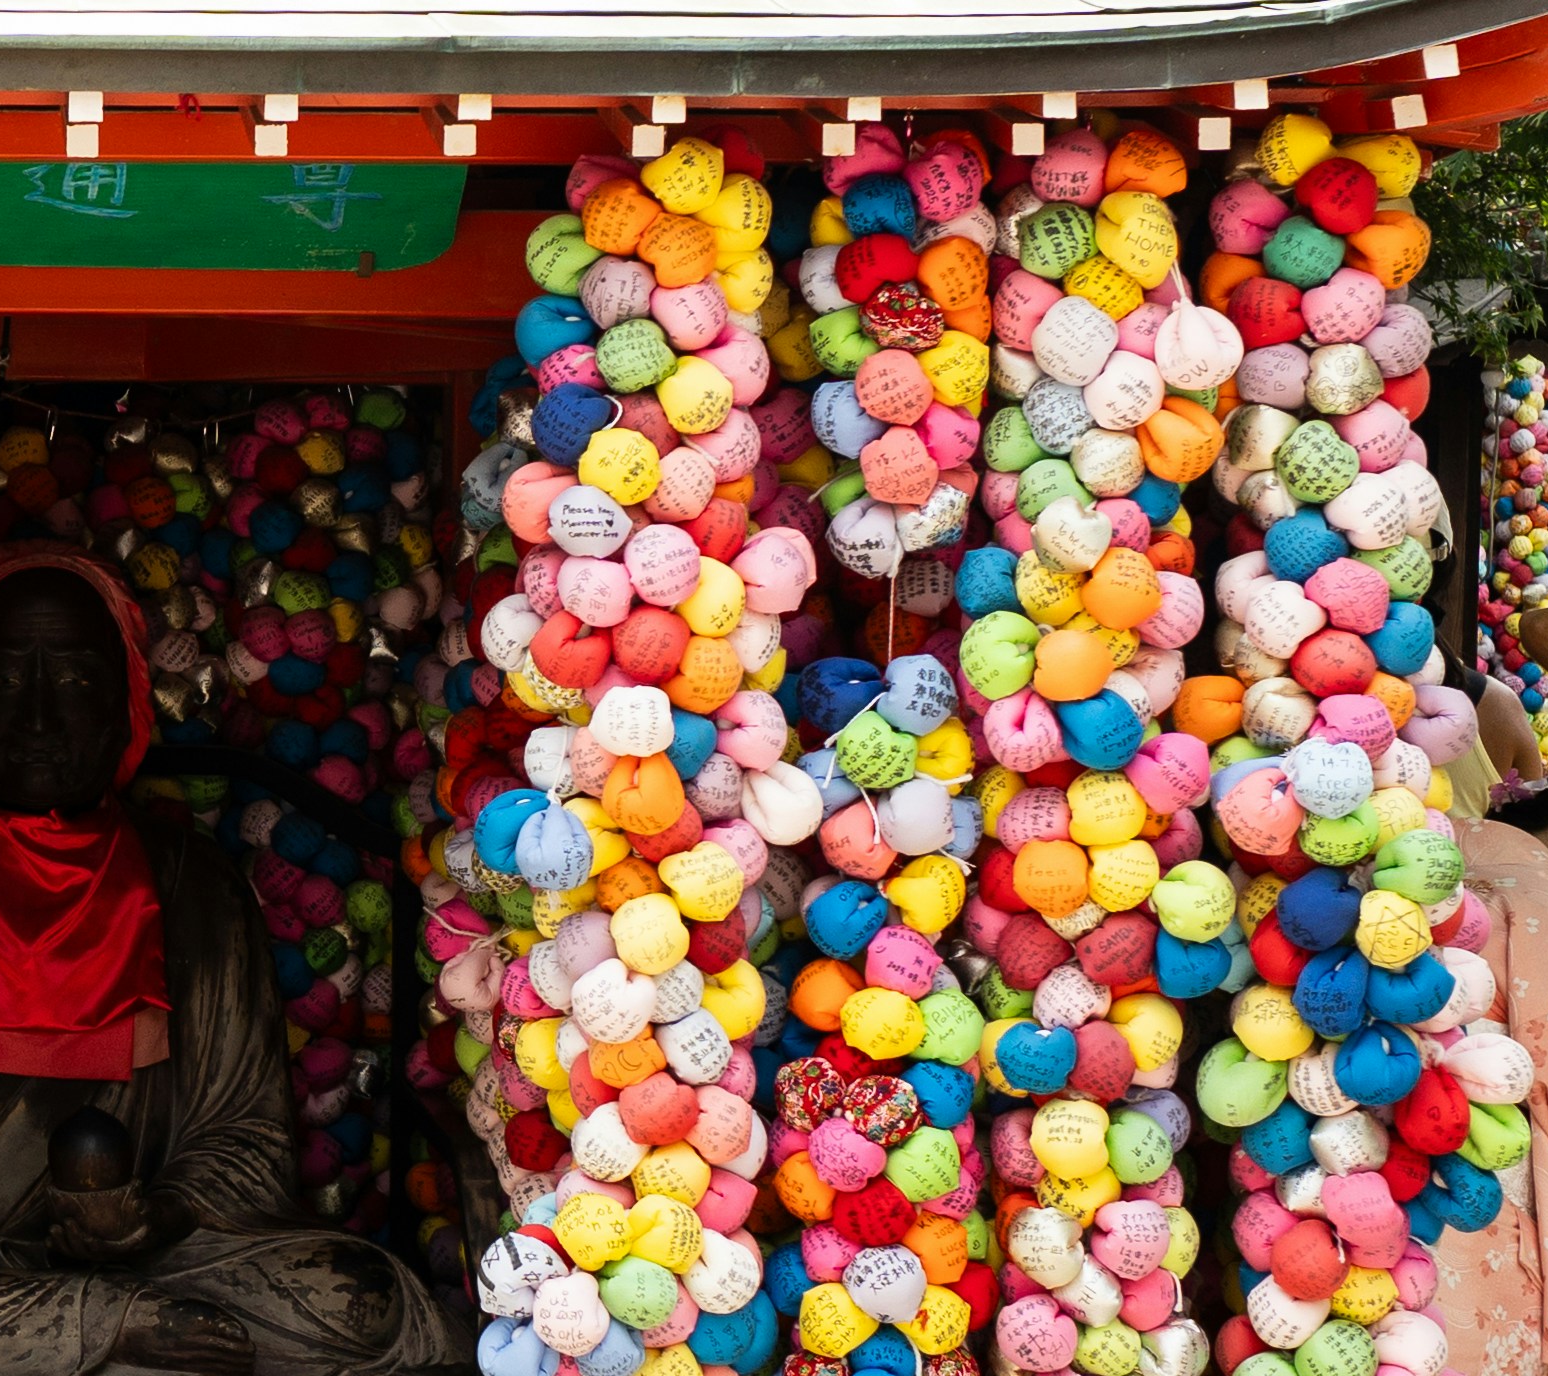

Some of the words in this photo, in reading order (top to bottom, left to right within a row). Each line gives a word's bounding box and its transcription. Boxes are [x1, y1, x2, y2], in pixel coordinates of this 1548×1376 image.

[1137, 217, 1176, 238] THEM
[1126, 232, 1175, 259] HOME
[563, 504, 594, 514] Please
